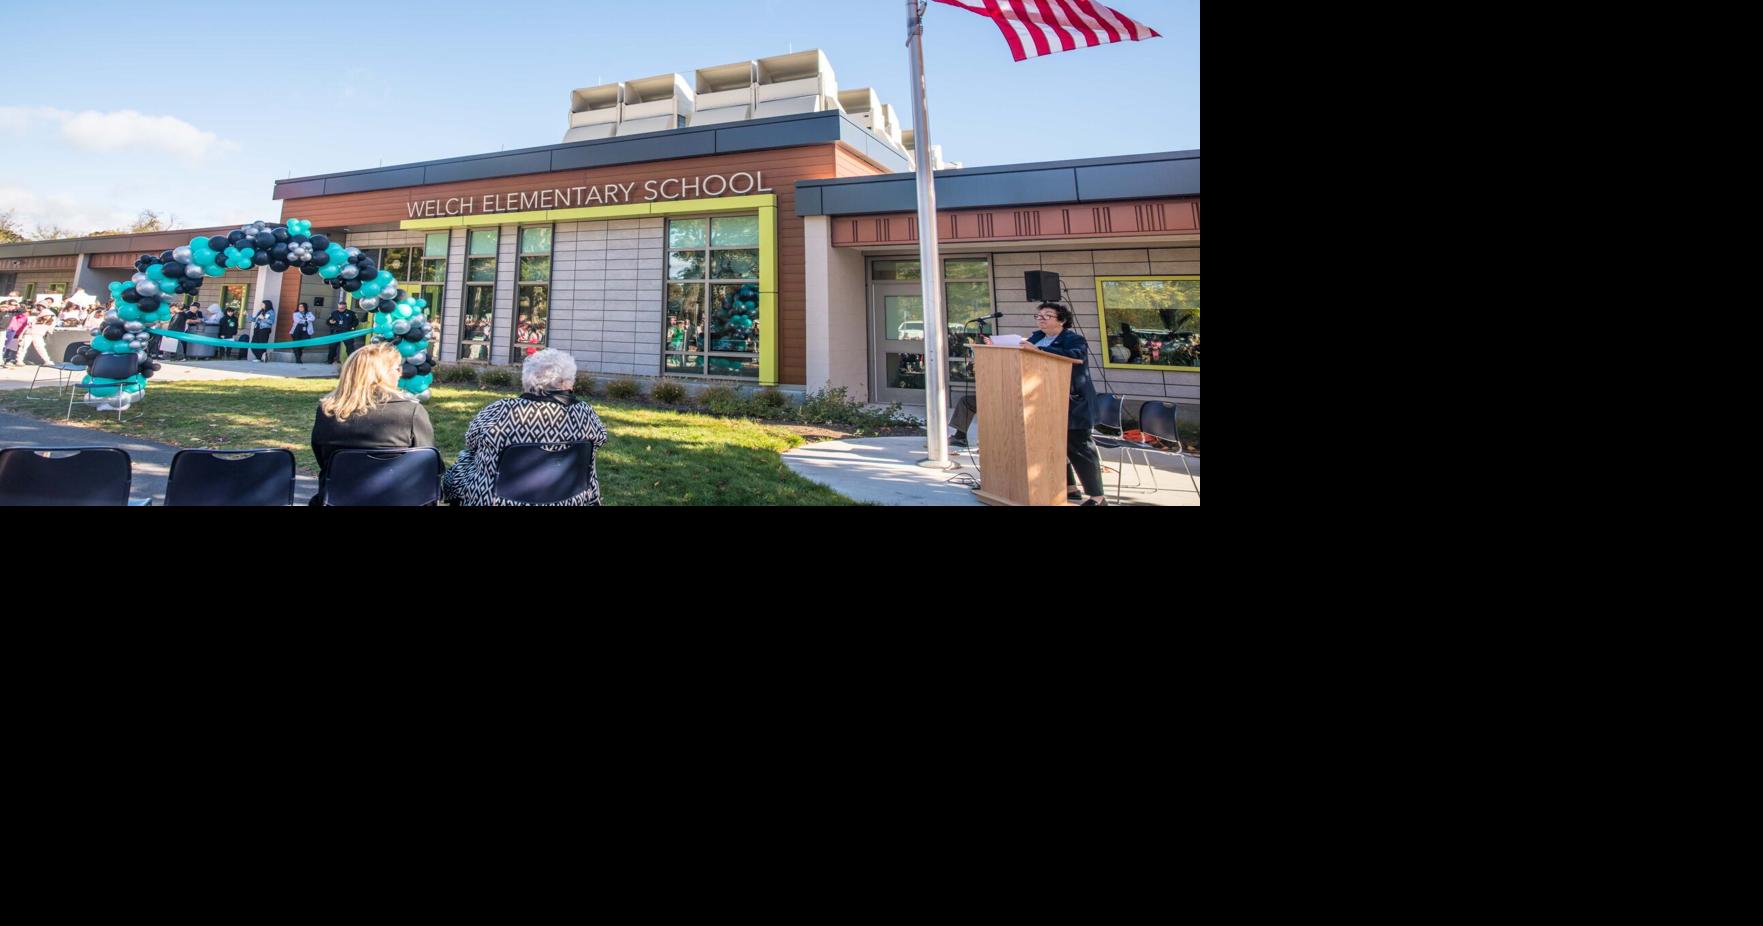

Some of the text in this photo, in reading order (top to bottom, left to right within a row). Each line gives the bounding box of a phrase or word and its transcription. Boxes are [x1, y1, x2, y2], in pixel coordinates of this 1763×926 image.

[407, 171, 772, 218] WELCH ELEMENTARY SCHOOL
